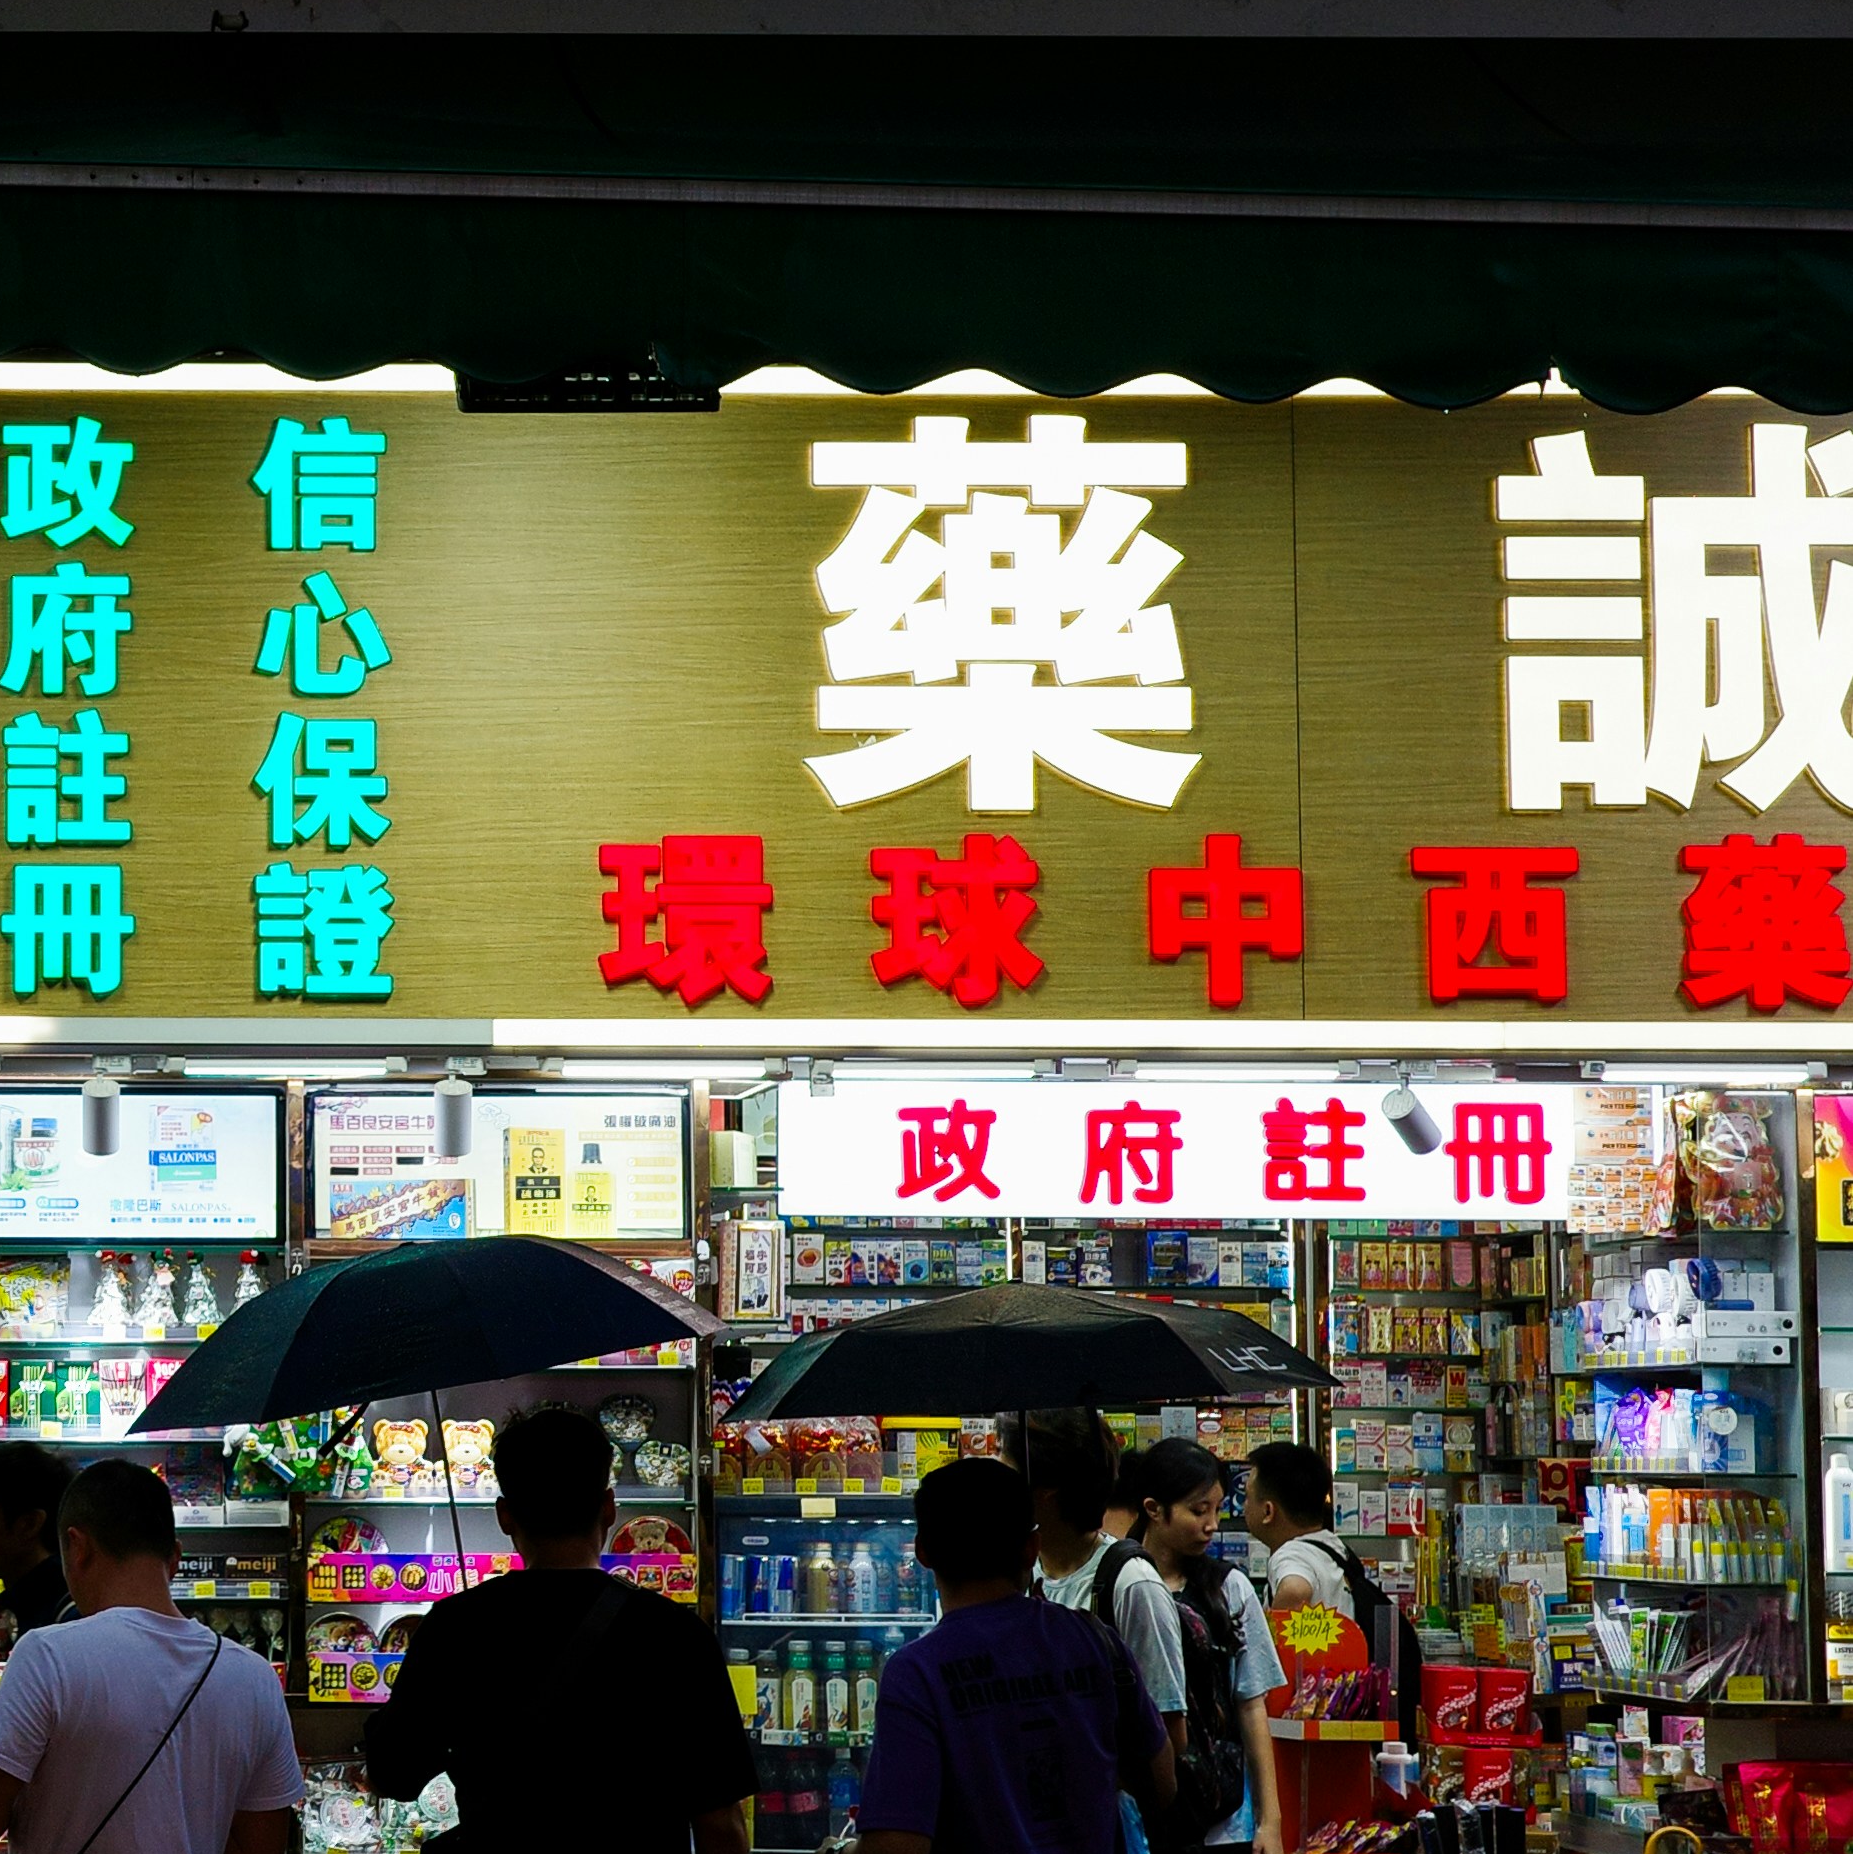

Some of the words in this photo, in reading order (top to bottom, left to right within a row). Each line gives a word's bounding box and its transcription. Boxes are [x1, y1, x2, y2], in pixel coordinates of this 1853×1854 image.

[0, 415, 136, 999] 政府註冊
[251, 415, 395, 1002] 信心保證
[158, 1151, 215, 1164] SALONPAS
[896, 1097, 1552, 1204] 政府註冊
[237, 1557, 277, 1573] meiji
[939, 1653, 995, 1685] NEW
